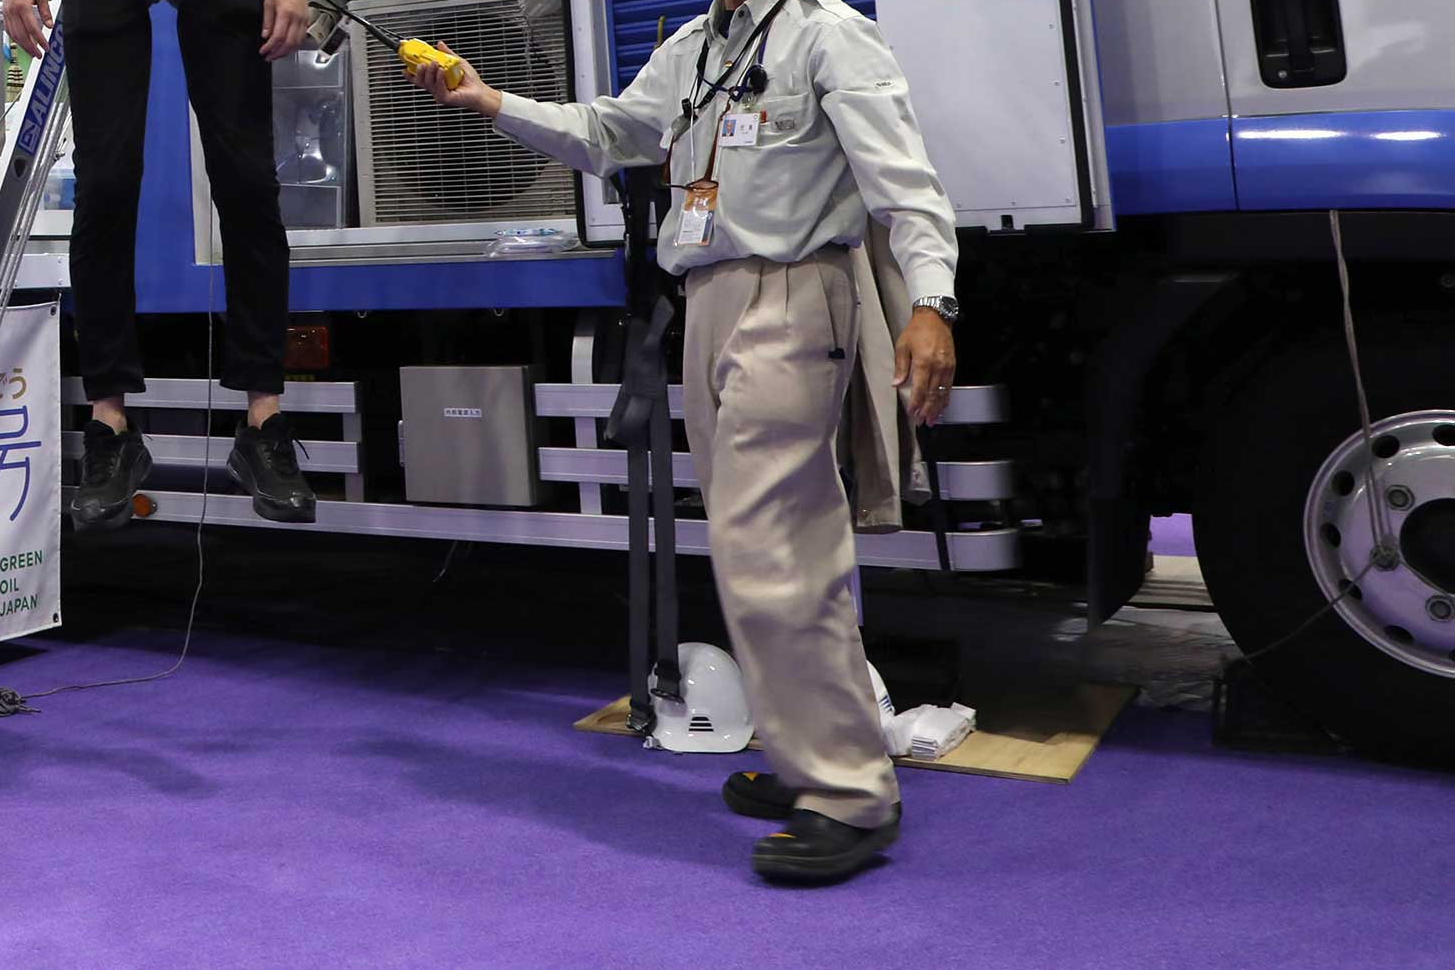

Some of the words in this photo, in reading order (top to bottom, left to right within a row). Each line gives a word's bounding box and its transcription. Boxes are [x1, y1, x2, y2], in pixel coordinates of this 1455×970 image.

[0, 550, 43, 572] GREEN
[0, 578, 20, 595] OIL
[0, 594, 38, 617] JAPAN
